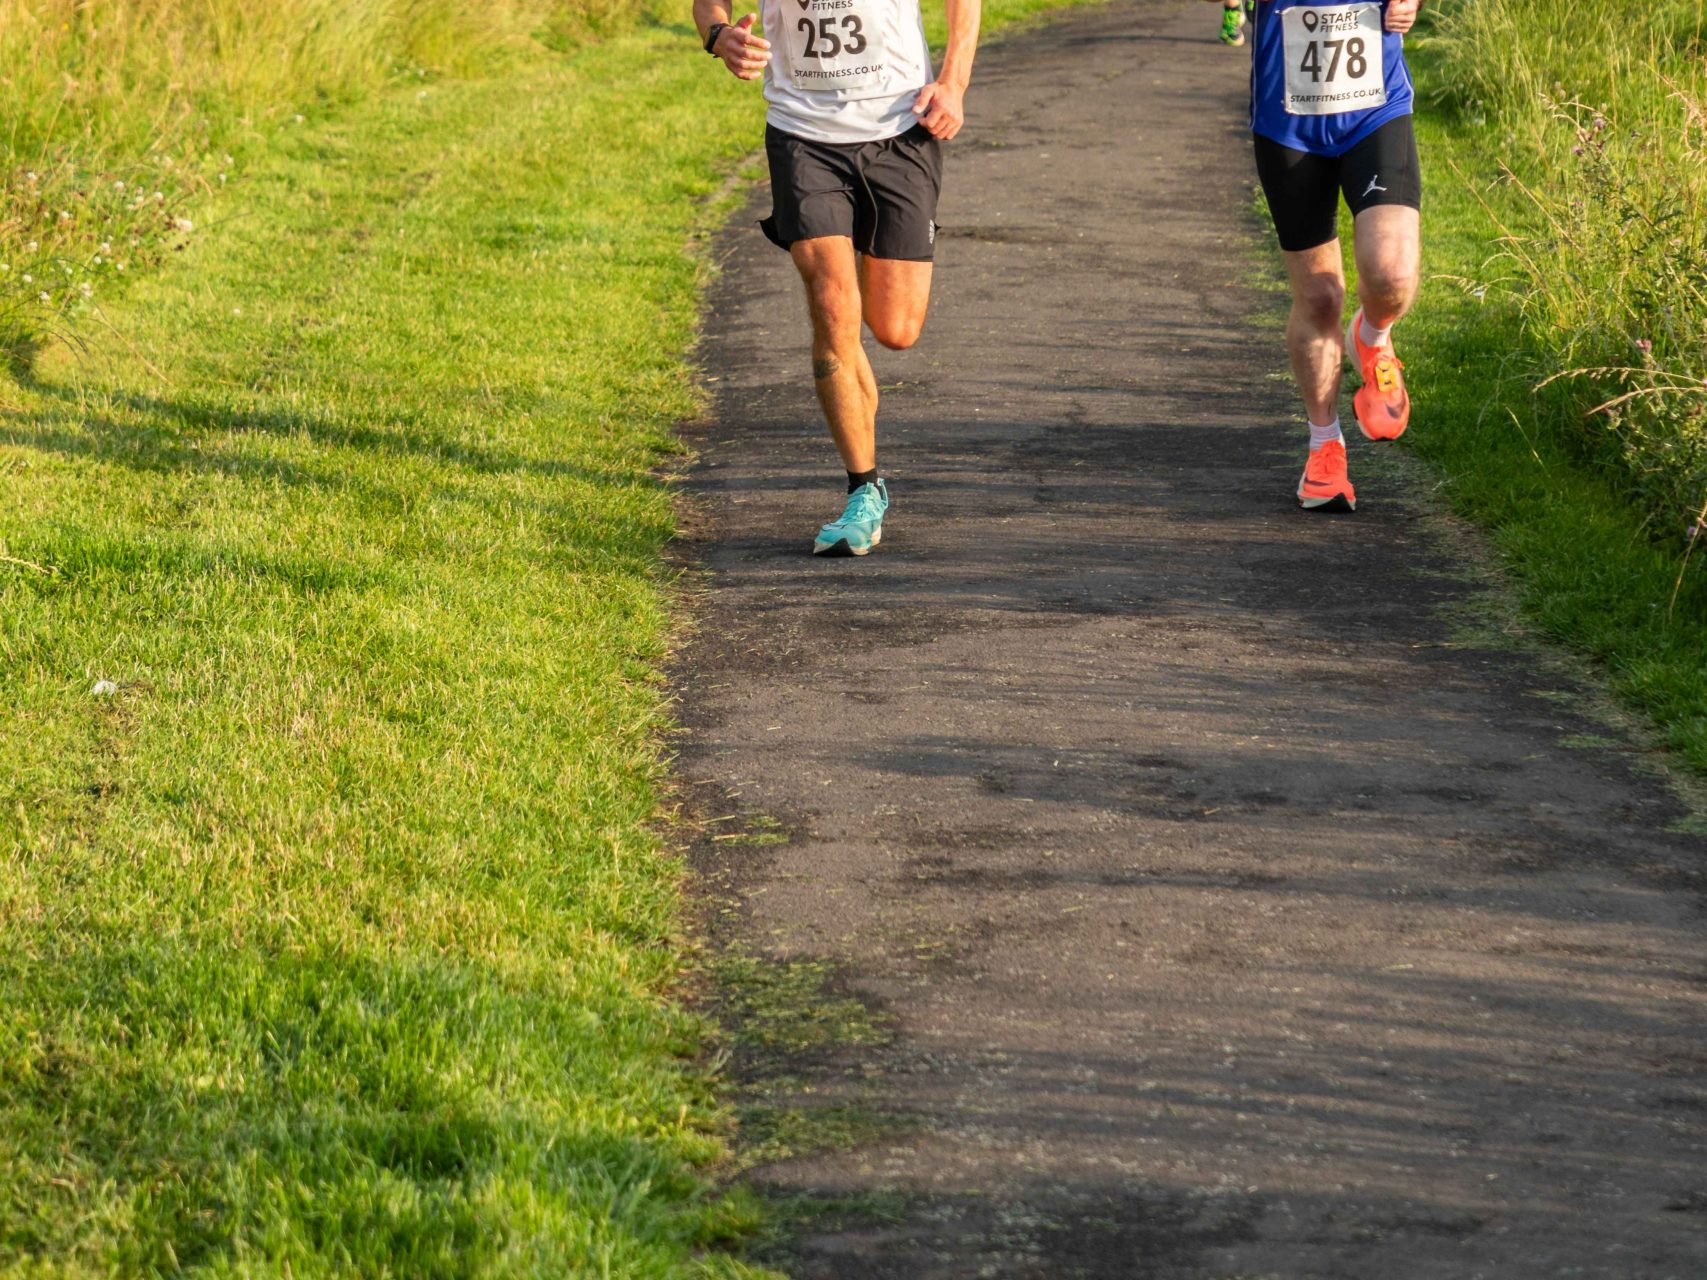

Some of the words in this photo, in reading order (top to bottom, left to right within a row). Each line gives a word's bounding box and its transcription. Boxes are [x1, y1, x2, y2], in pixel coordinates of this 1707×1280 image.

[812, 0, 853, 11] FITNESS
[1320, 10, 1360, 24] START
[1320, 20, 1359, 33] FITNESS
[797, 14, 867, 59] 253
[1300, 36, 1367, 83] 478
[794, 63, 883, 79] STARTFITNESS.CO.UK
[1290, 87, 1382, 103] STARTFITNESS.CO.UK
